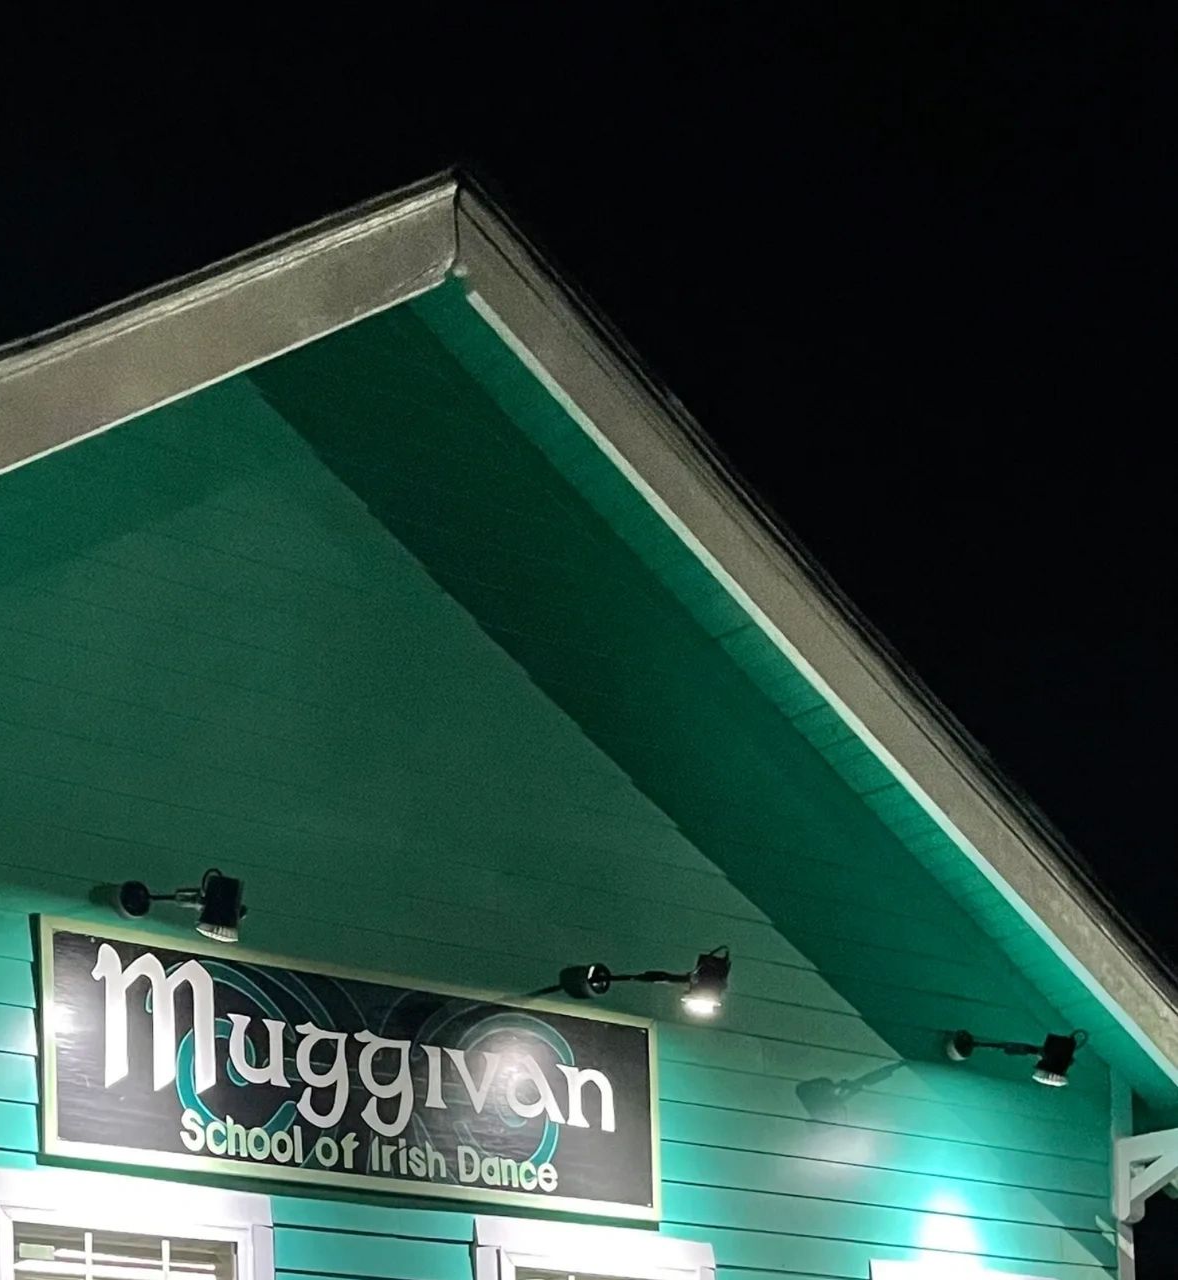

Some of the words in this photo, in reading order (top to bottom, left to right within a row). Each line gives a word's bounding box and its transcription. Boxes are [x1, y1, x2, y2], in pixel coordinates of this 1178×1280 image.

[91, 942, 616, 1137] Muggivan
[180, 1108, 304, 1164] School
[315, 1132, 361, 1169] of
[372, 1135, 447, 1178] Irish
[457, 1145, 559, 1192] Dance
